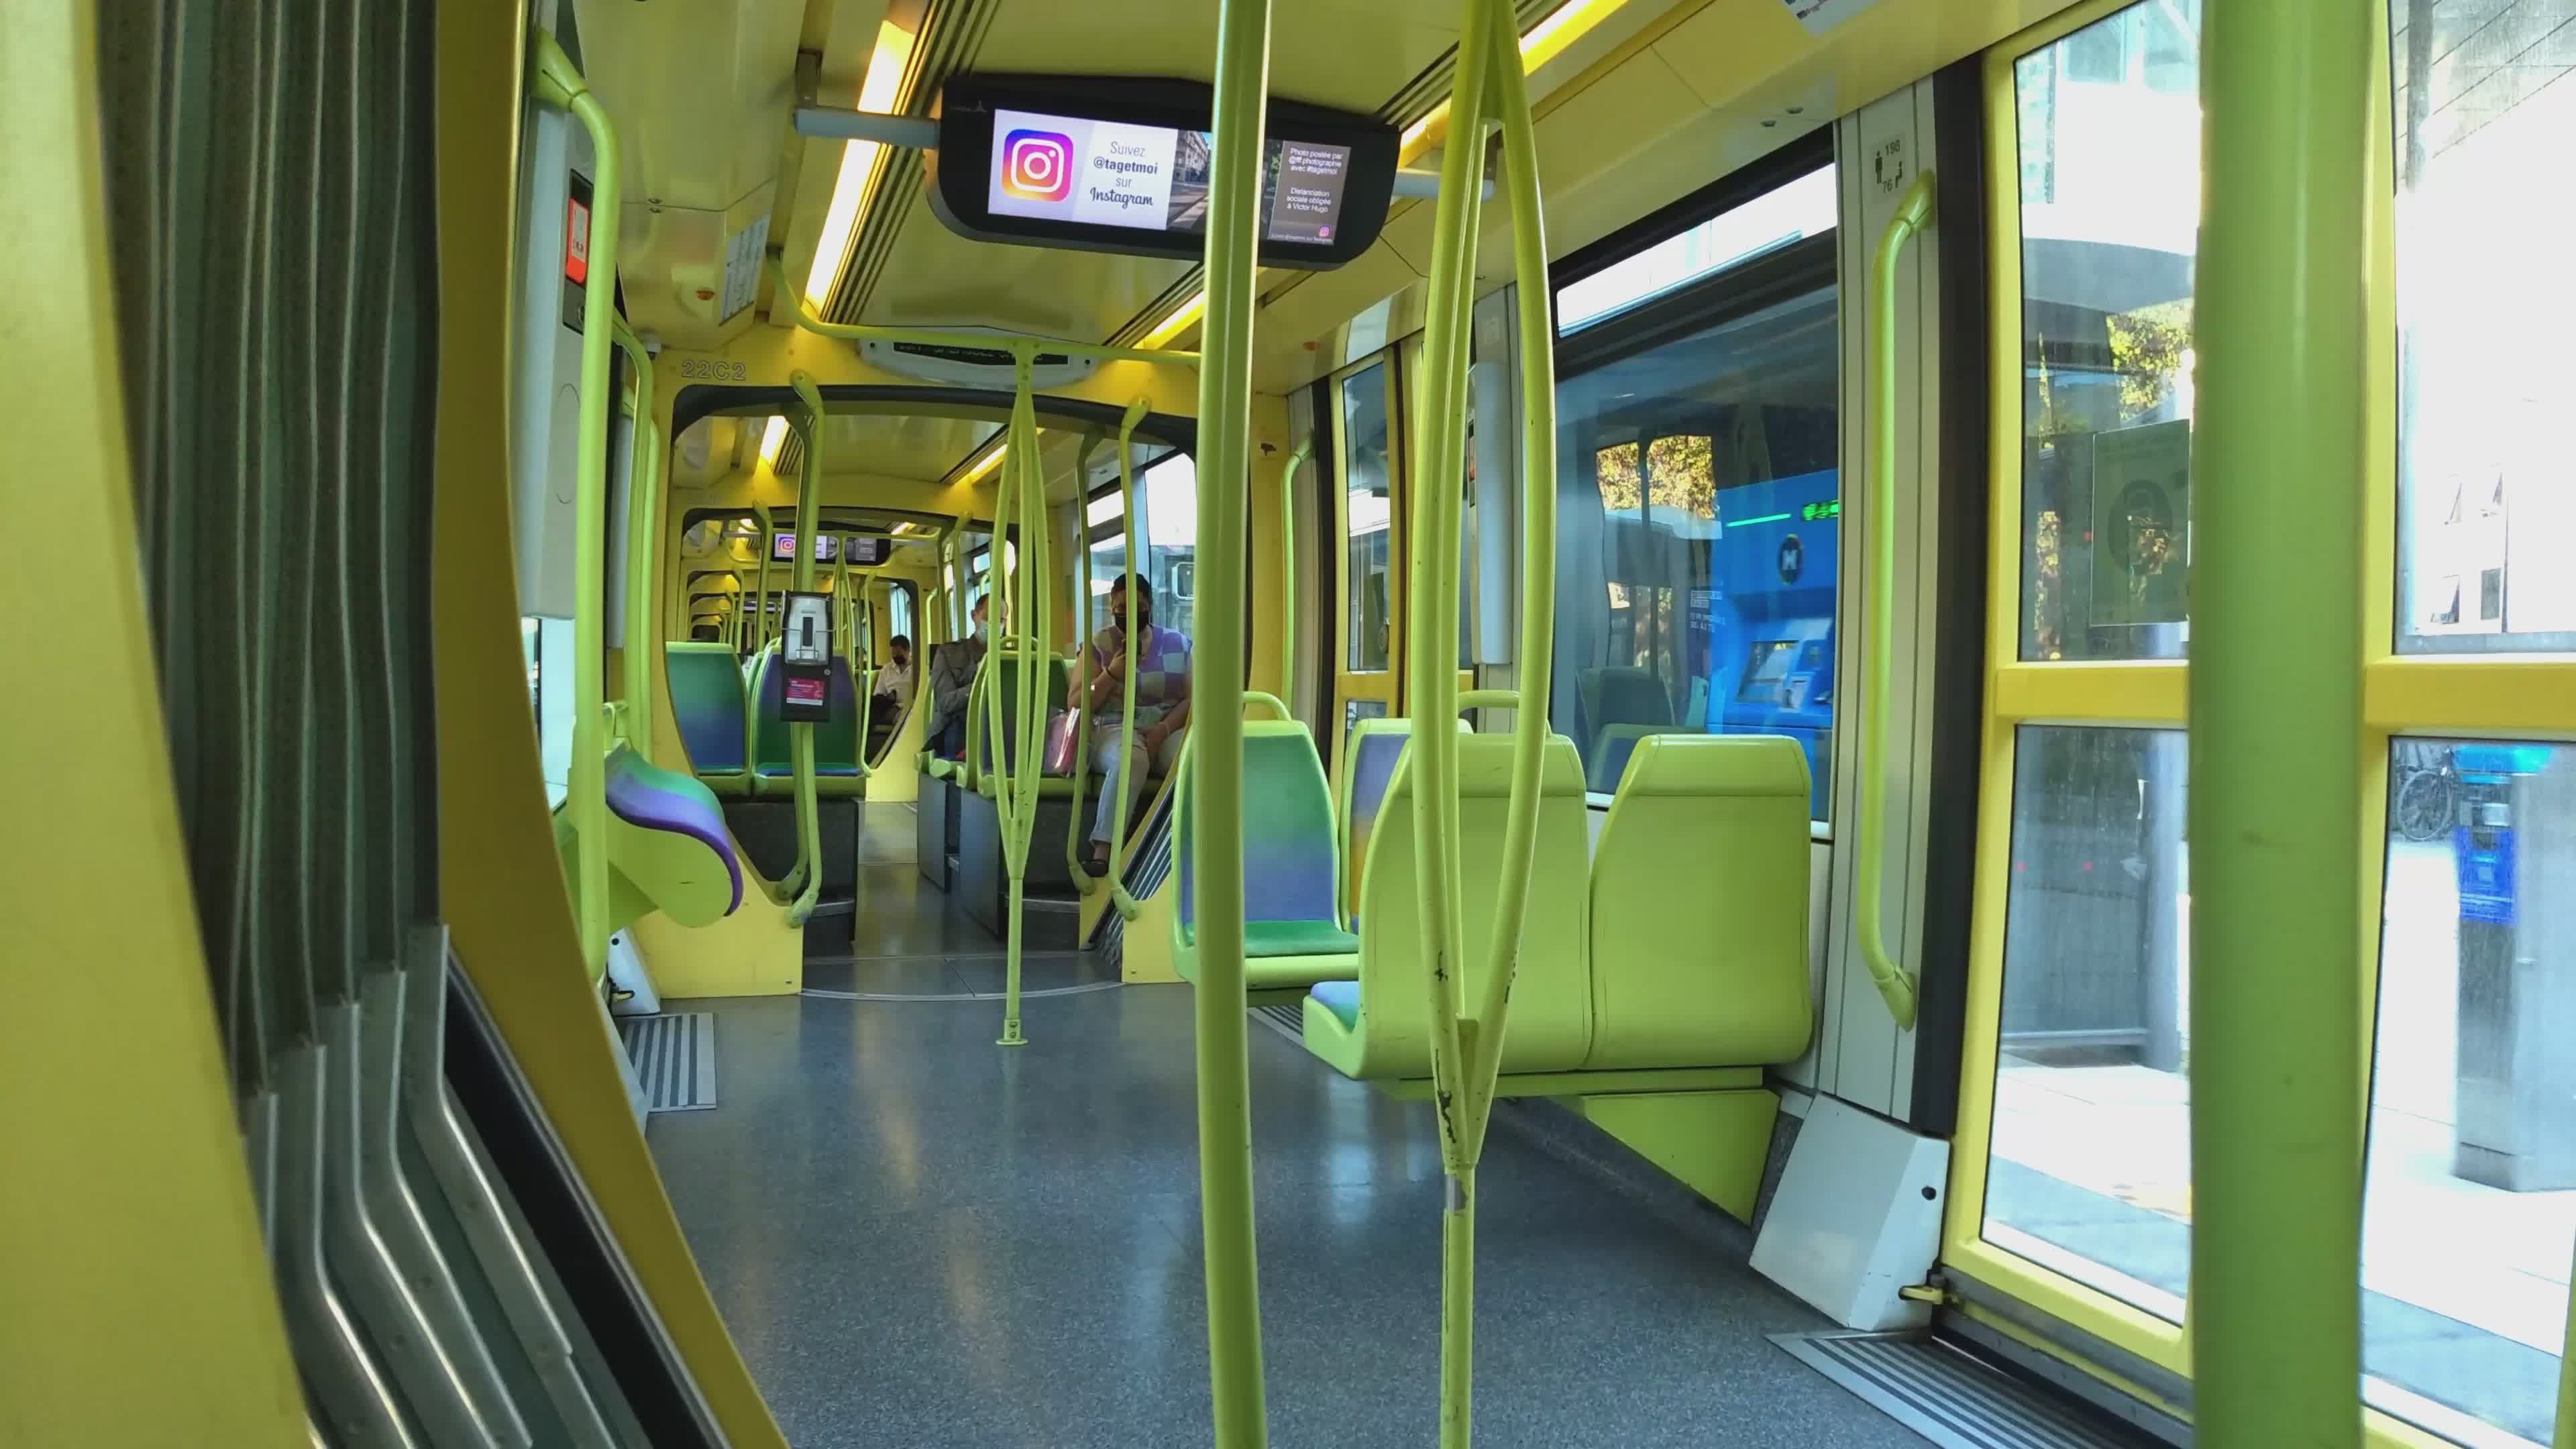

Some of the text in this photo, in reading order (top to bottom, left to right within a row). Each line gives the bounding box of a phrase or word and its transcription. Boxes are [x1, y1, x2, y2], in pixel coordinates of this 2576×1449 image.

[1110, 141, 1146, 157] Suivez
[1290, 148, 1309, 156] Photo
[1885, 139, 1900, 156] 198
[1093, 156, 1159, 174] @tagetmoi
[1116, 177, 1132, 189] sur
[1090, 187, 1153, 209] Instagram
[1311, 205, 1328, 213] Hugo
